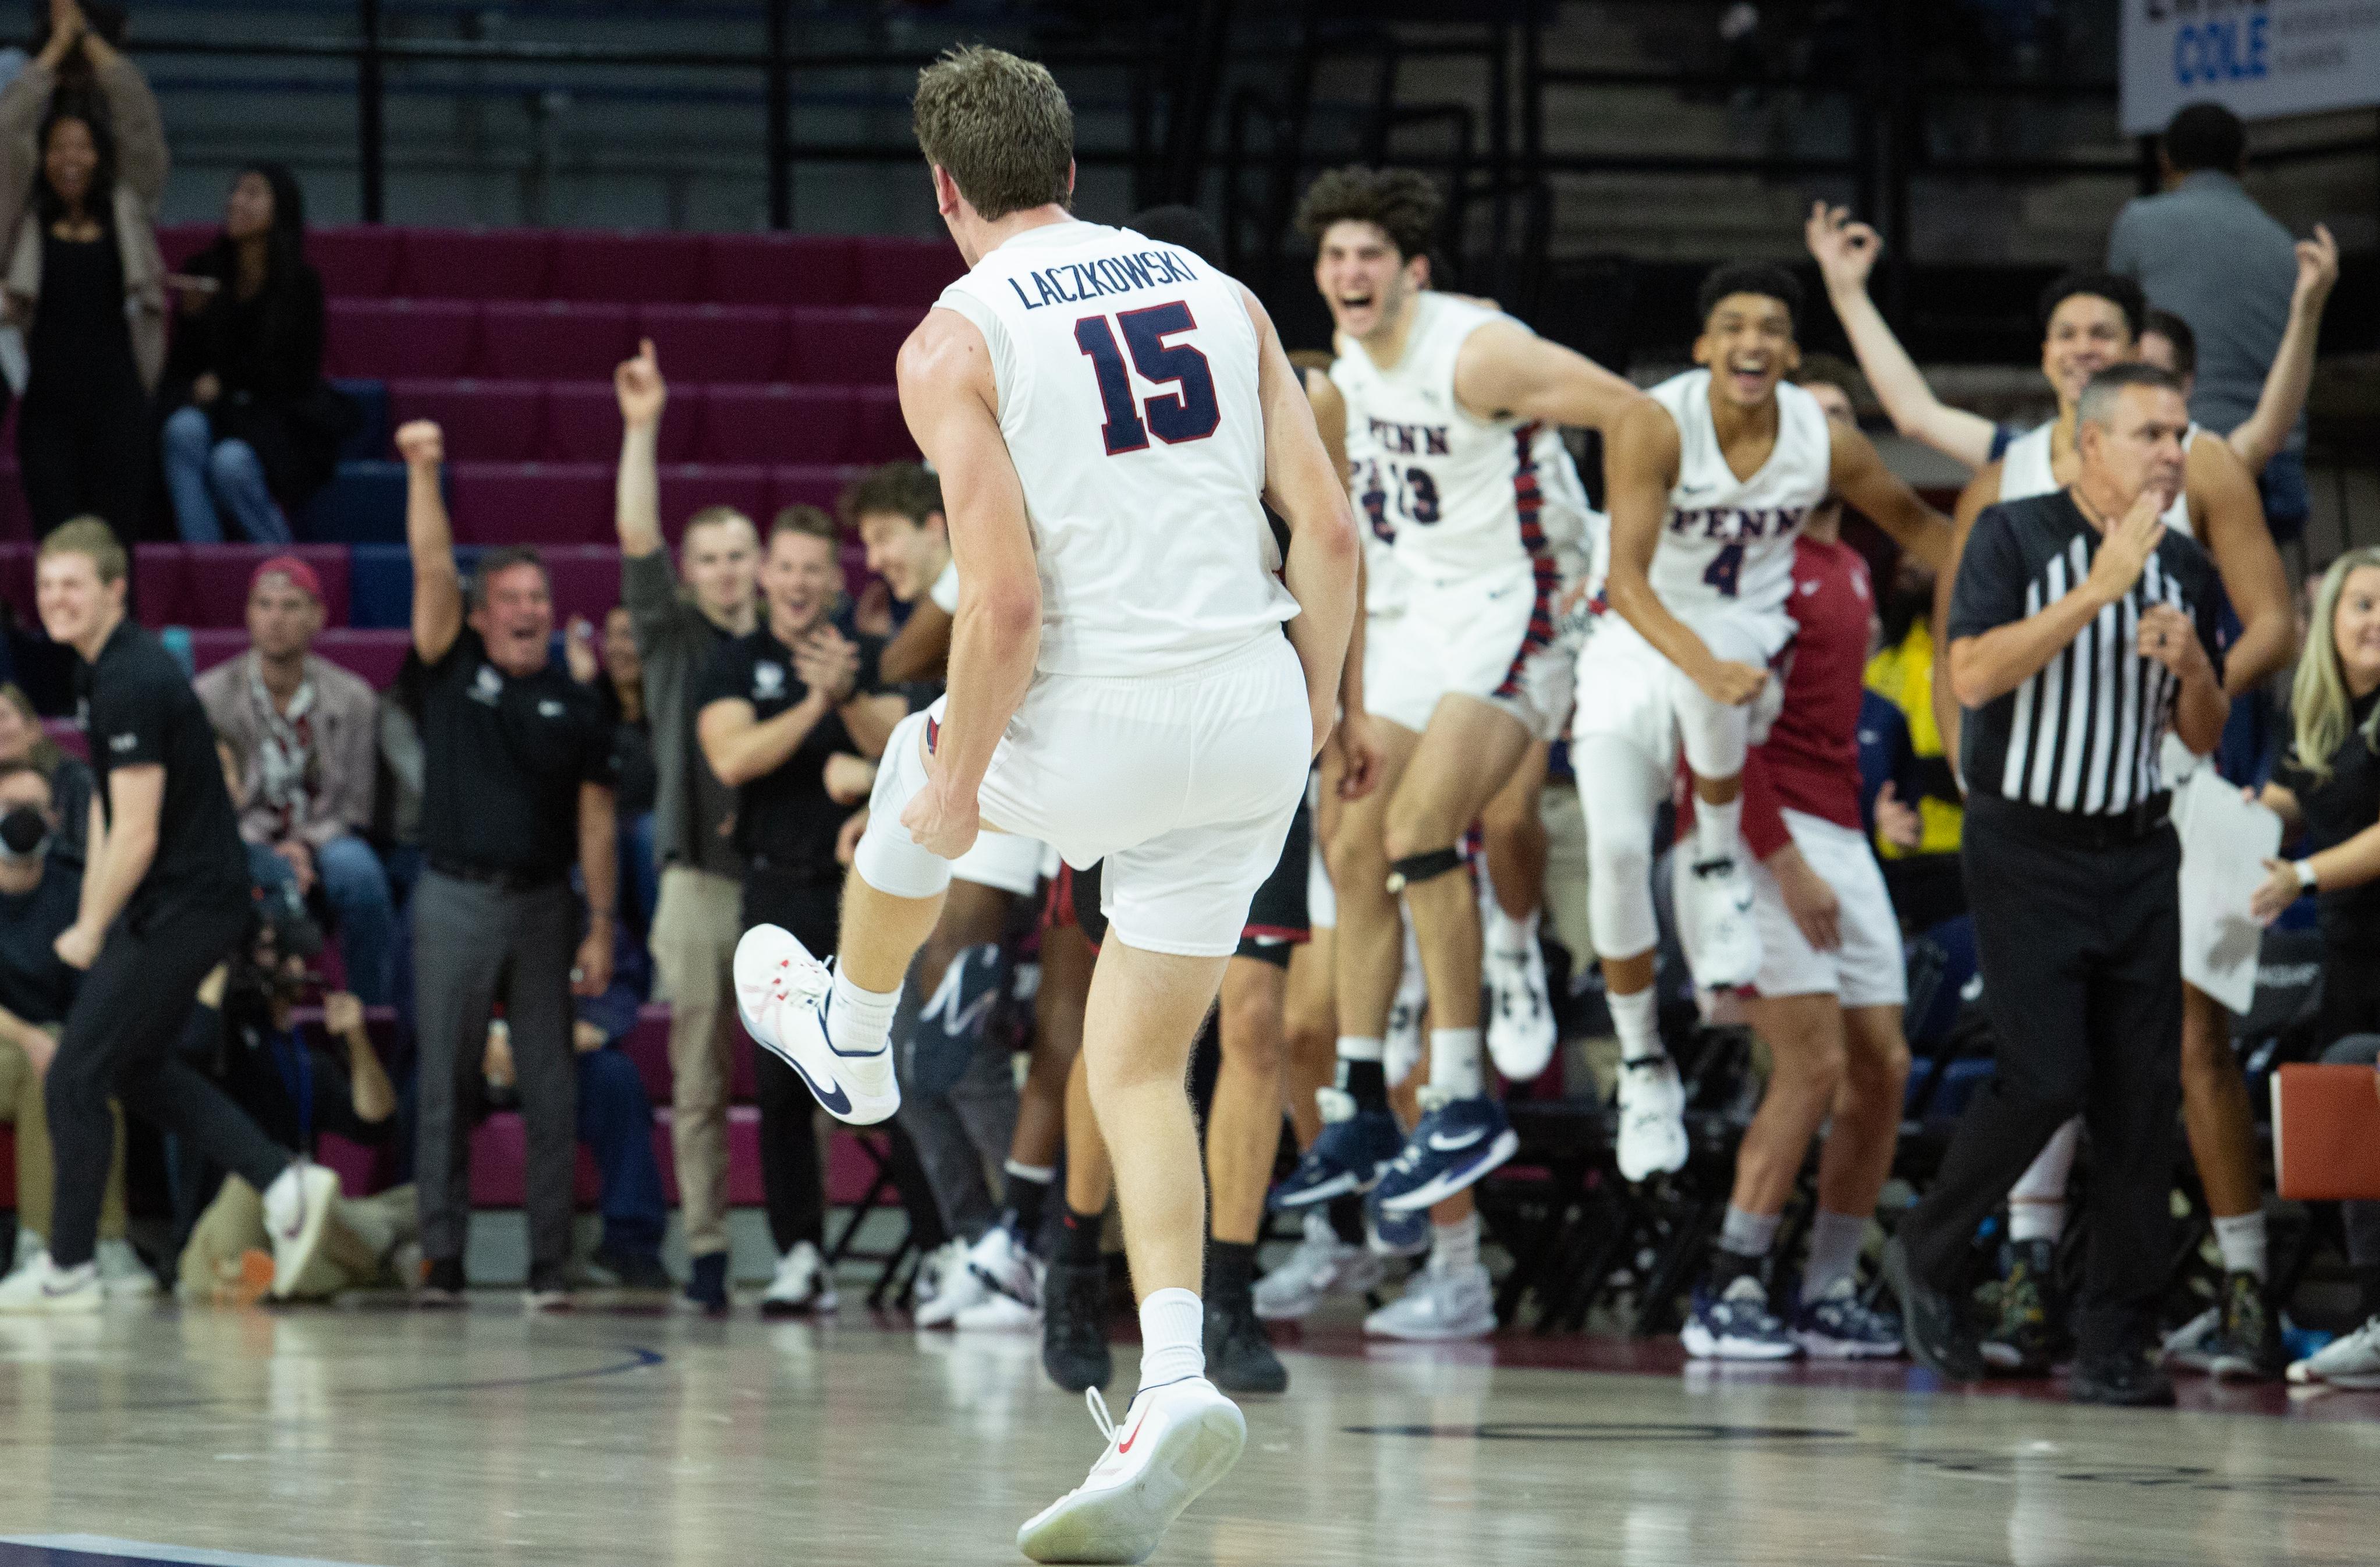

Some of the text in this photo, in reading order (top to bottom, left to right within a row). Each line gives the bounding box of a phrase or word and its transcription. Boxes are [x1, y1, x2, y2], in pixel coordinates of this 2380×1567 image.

[2175, 13, 2268, 86] COLE
[1008, 251, 1198, 310] LACZKOWSKI
[1074, 300, 1221, 456] 15
[1670, 505, 1804, 539] PENN
[1703, 543, 1744, 598] 4
